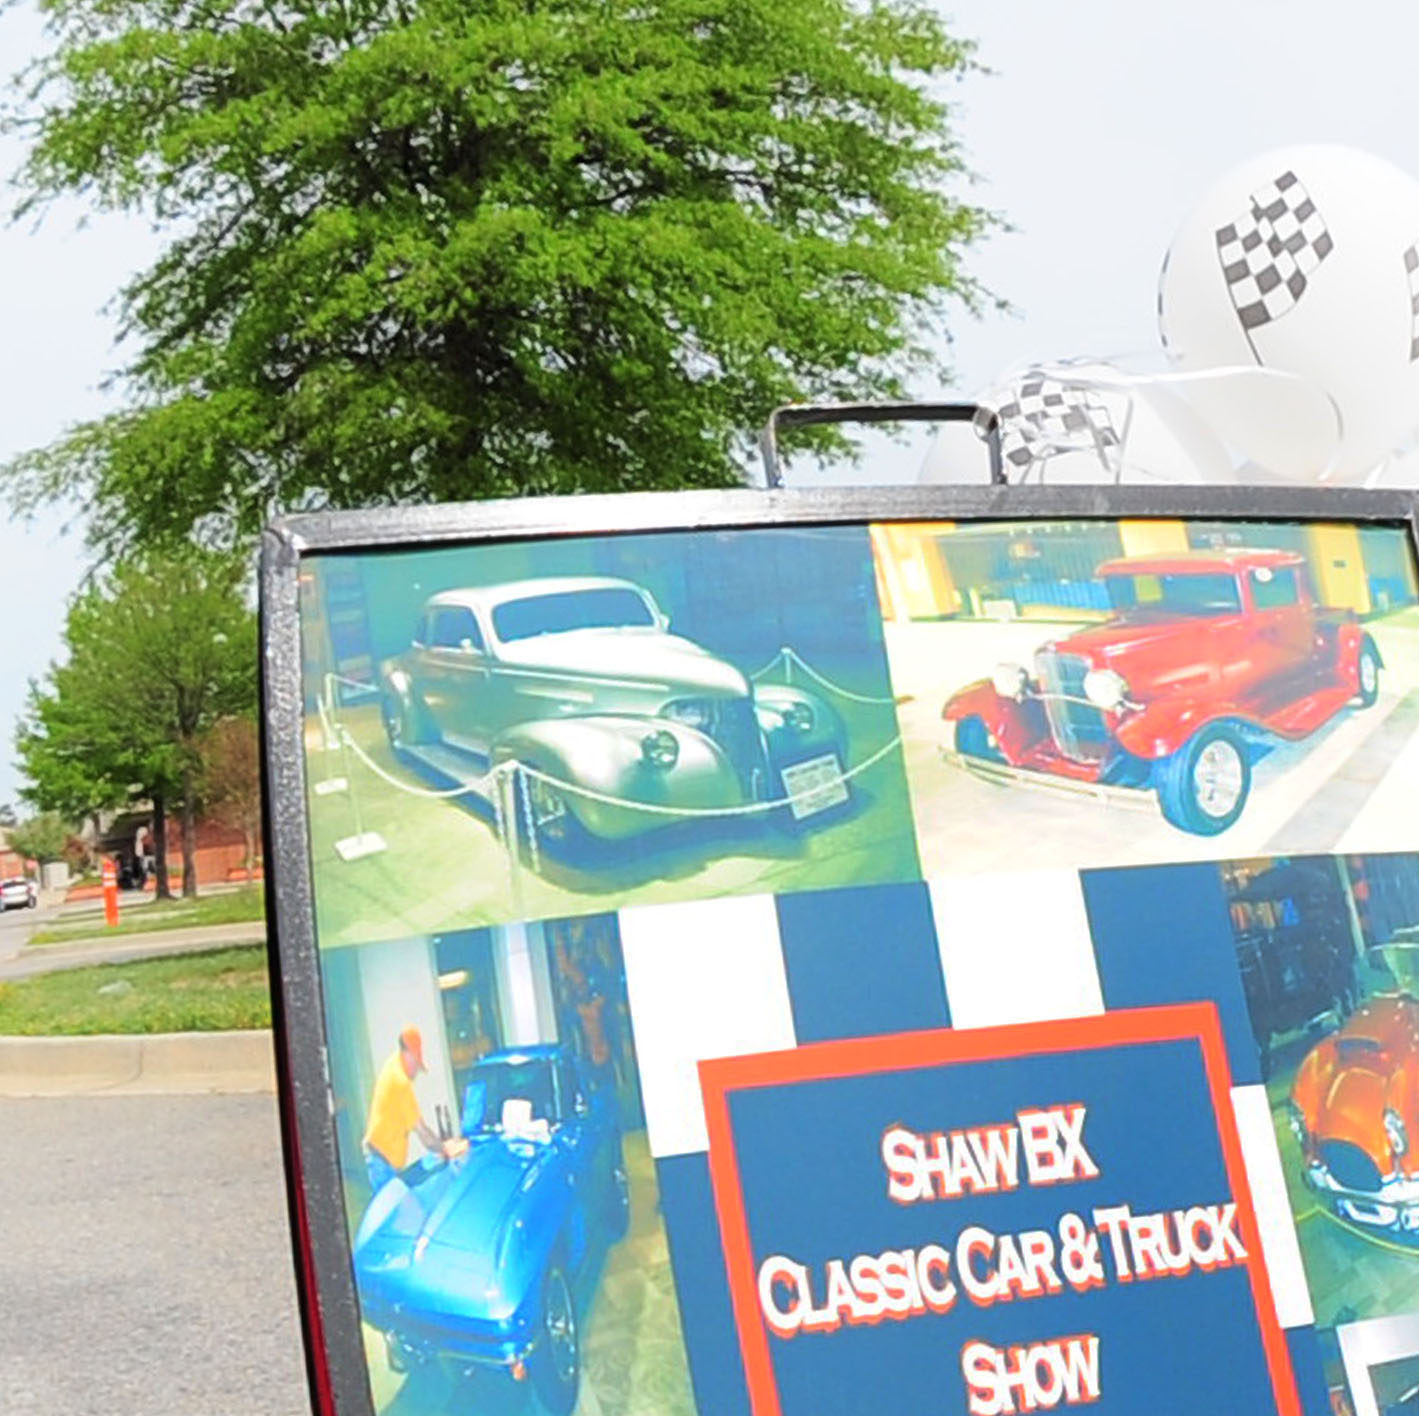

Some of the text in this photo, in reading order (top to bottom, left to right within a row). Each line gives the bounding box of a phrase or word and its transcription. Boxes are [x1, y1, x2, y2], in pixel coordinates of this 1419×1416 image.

[880, 1106, 1101, 1202] SHAW BX
[756, 1201, 1249, 1331] CLASSIC CAR & TRUCK
[960, 1336, 1102, 1416] SHOW
